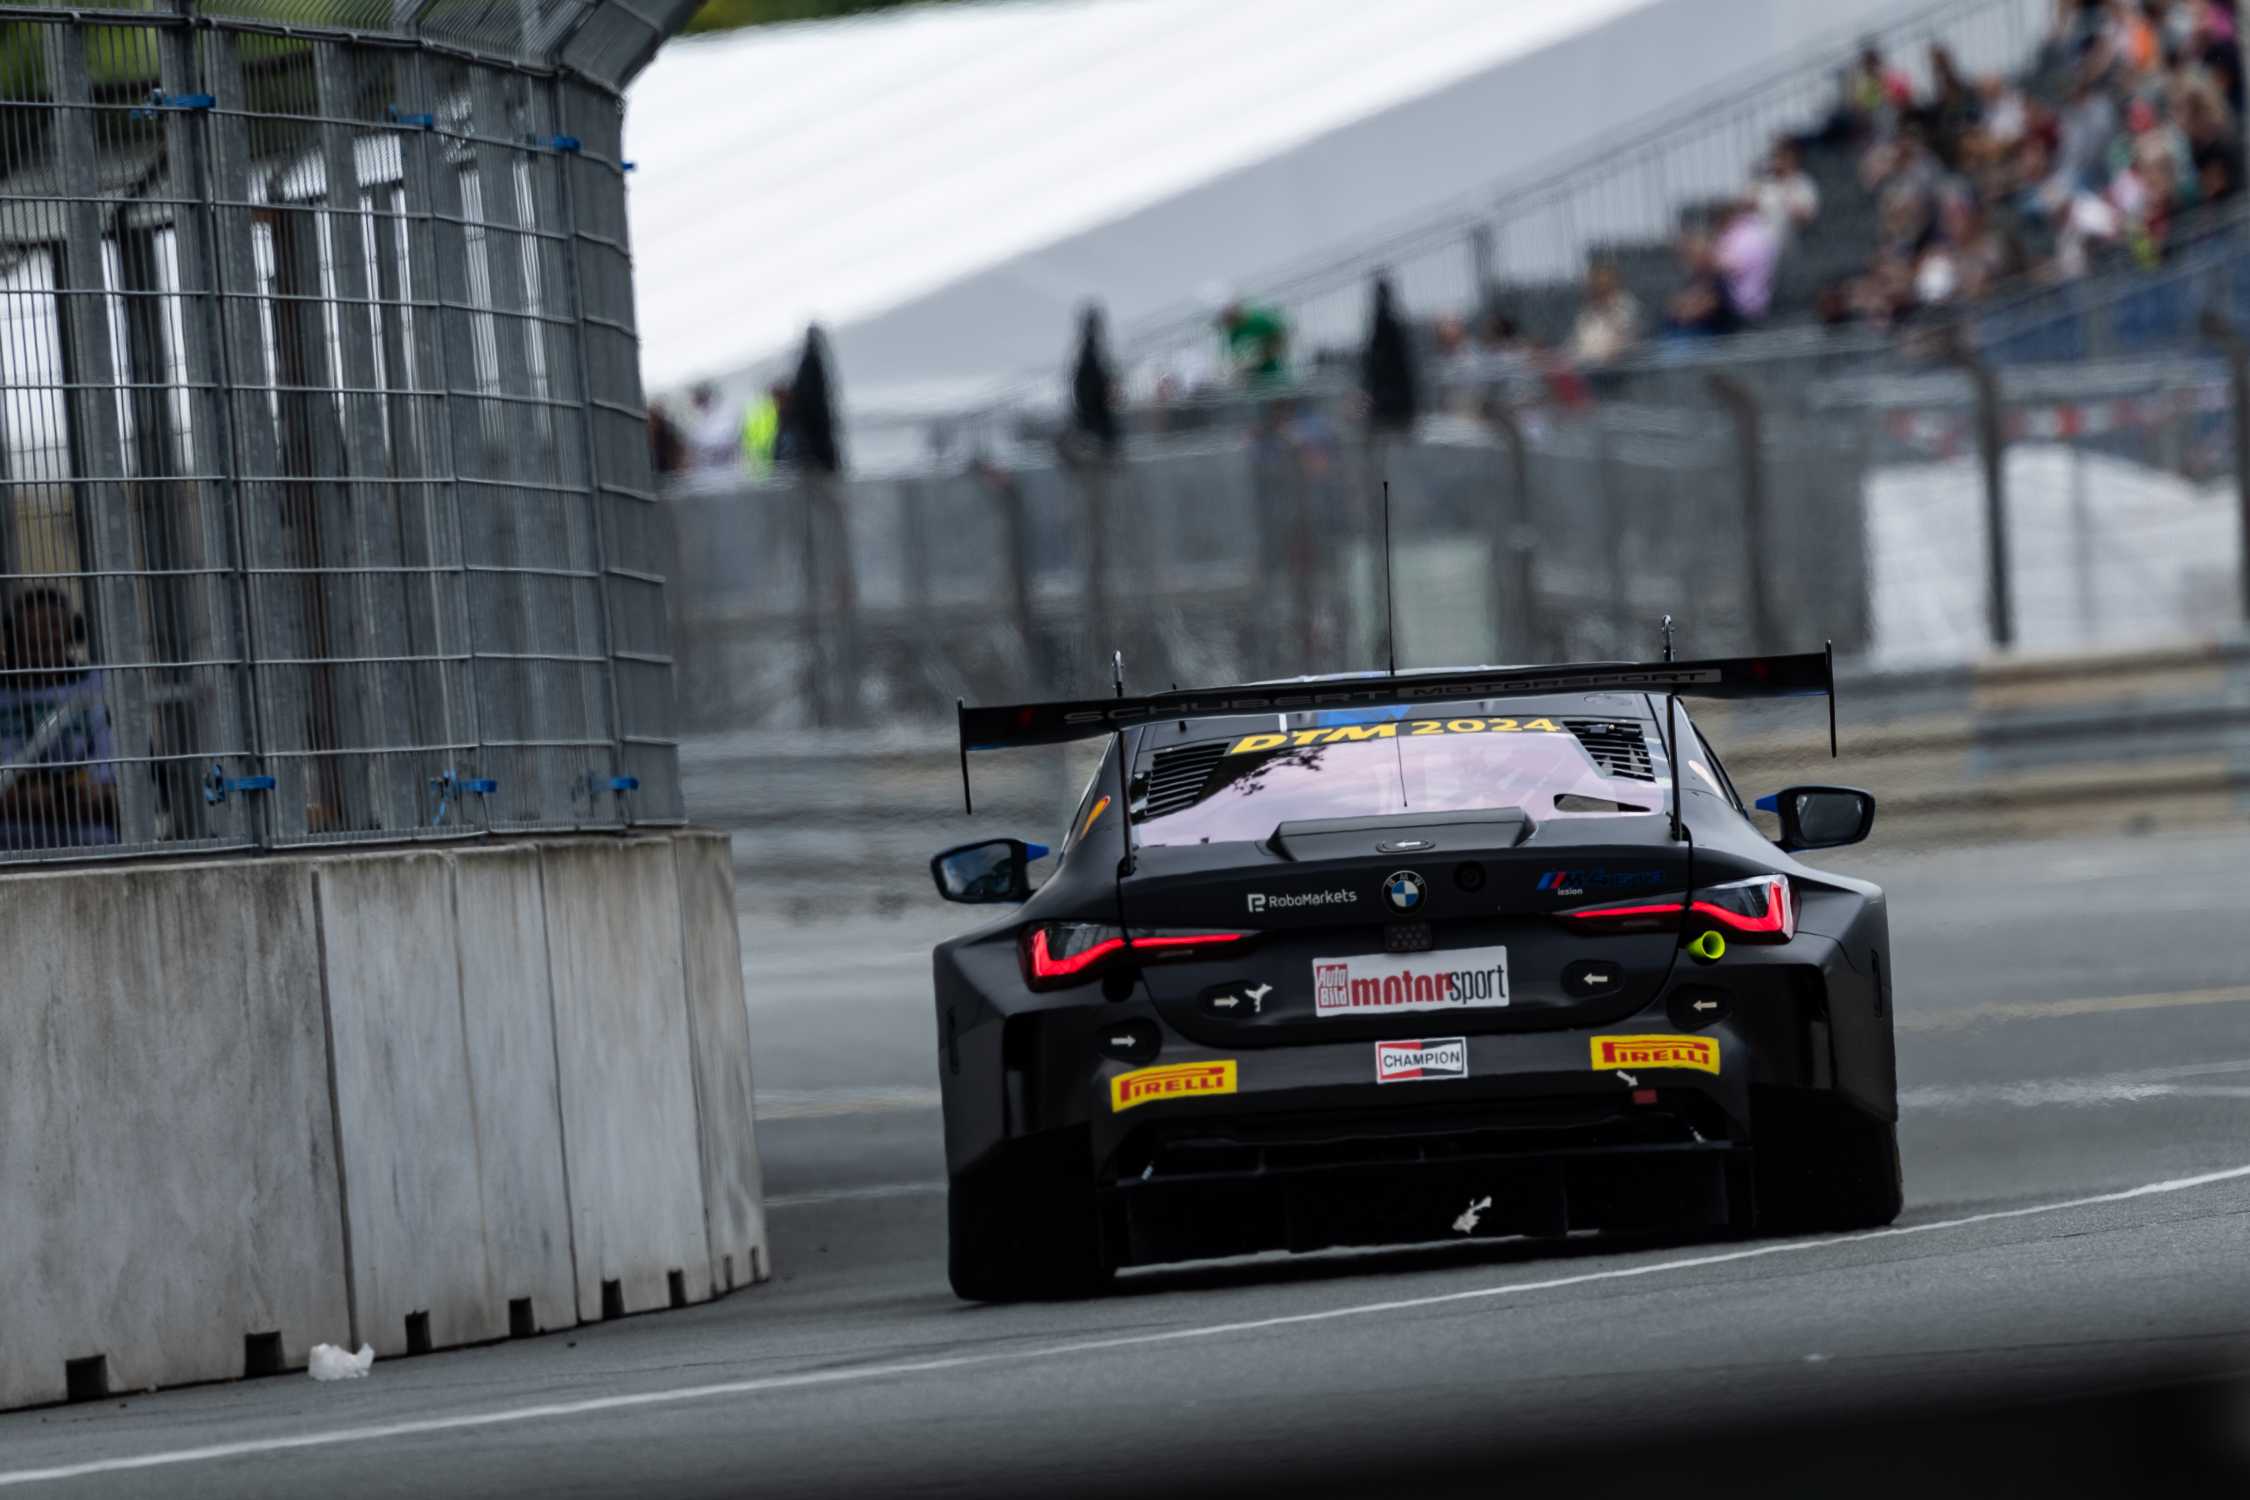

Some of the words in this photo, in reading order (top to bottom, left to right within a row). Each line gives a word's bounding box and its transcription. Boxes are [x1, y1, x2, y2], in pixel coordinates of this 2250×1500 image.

[1063, 689, 1391, 724] SCHUBERT
[1412, 672, 1708, 695] MOTORSPORT
[1230, 722, 1398, 754] DTM
[1411, 718, 1561, 735] 2024
[1268, 888, 1358, 908] RoboMarkets
[1318, 966, 1347, 988] Auto
[1383, 1051, 1460, 1068] CHAMPION
[1601, 1040, 1710, 1065] PIRELLI
[1119, 1066, 1225, 1105] PIRELLI
